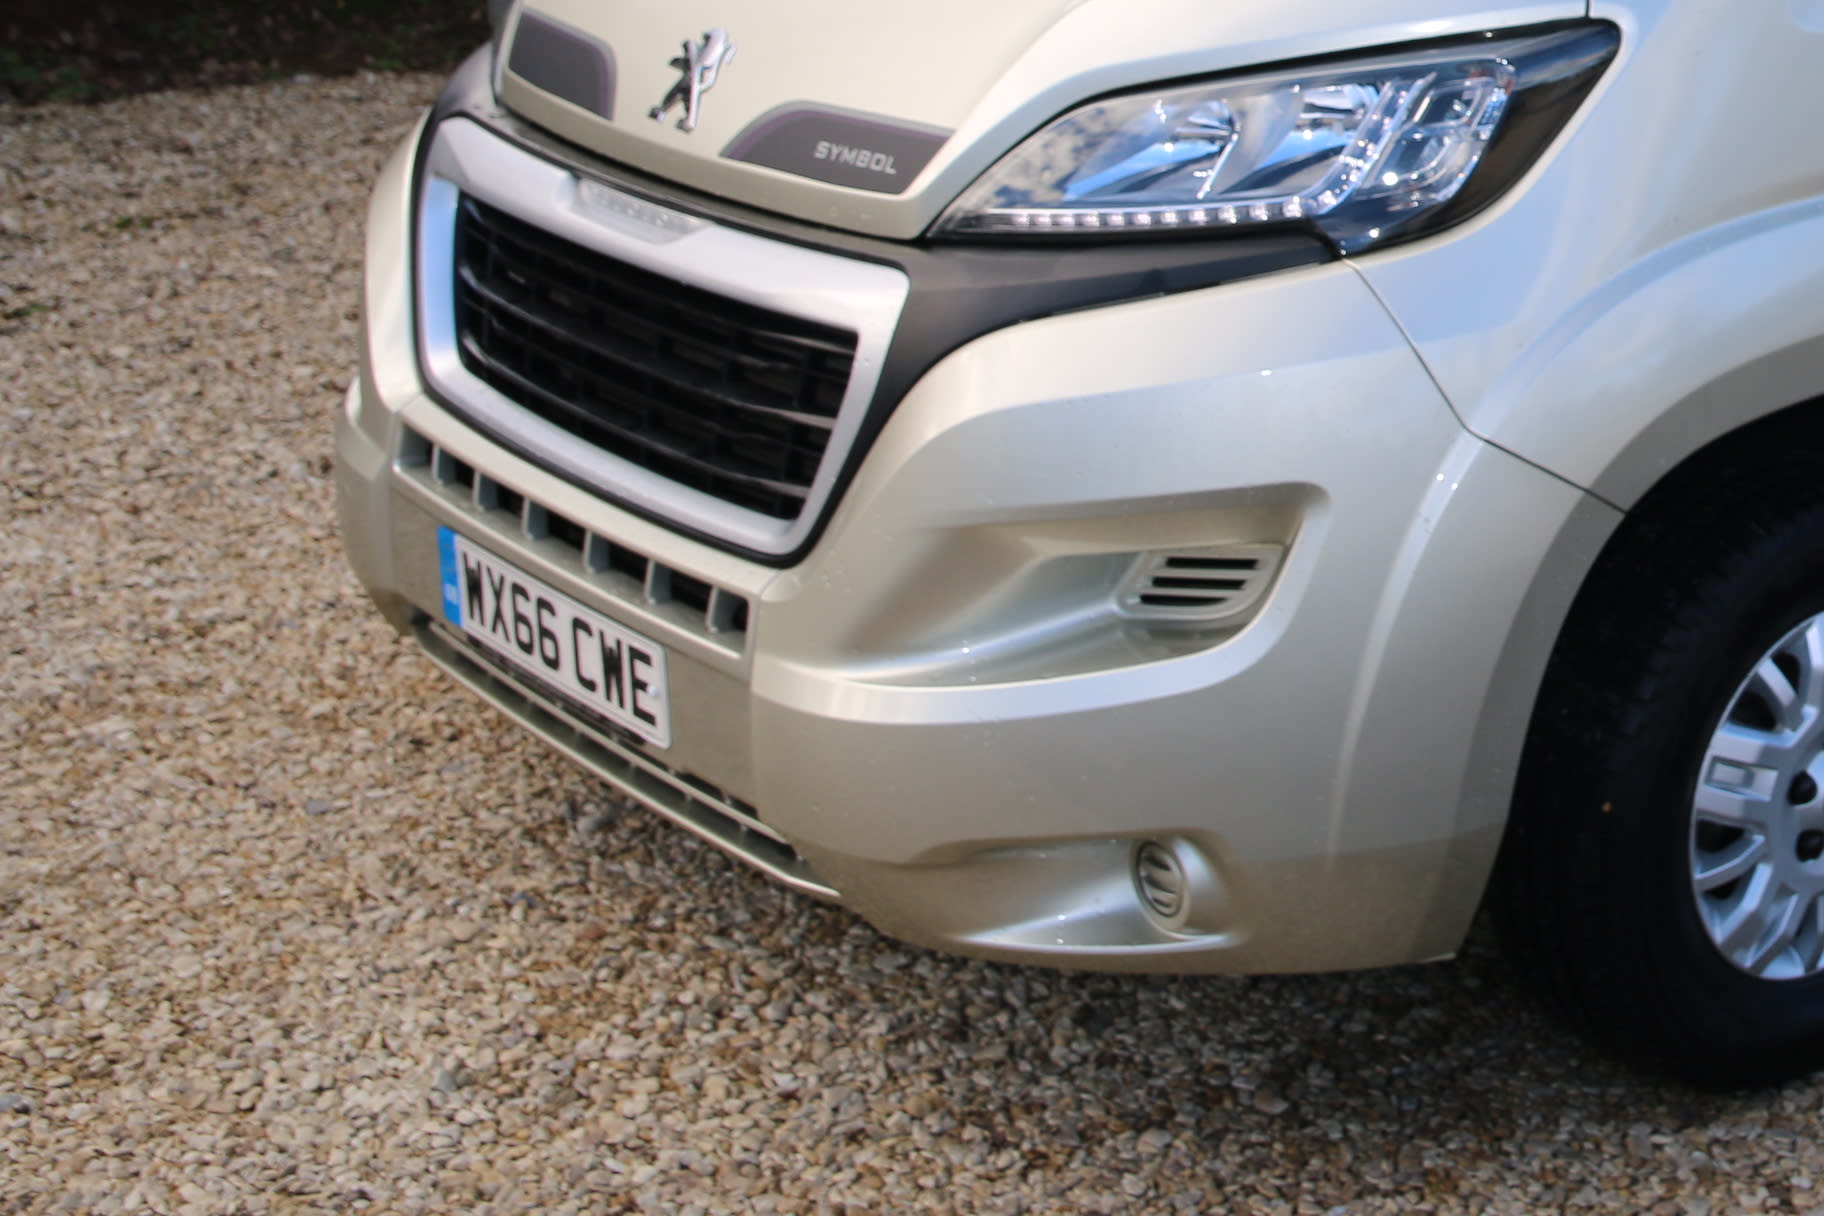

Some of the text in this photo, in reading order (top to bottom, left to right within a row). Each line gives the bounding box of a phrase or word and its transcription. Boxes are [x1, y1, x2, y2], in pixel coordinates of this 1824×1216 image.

[813, 140, 898, 175] SYMBOL
[462, 551, 658, 728] WX66 CWE
